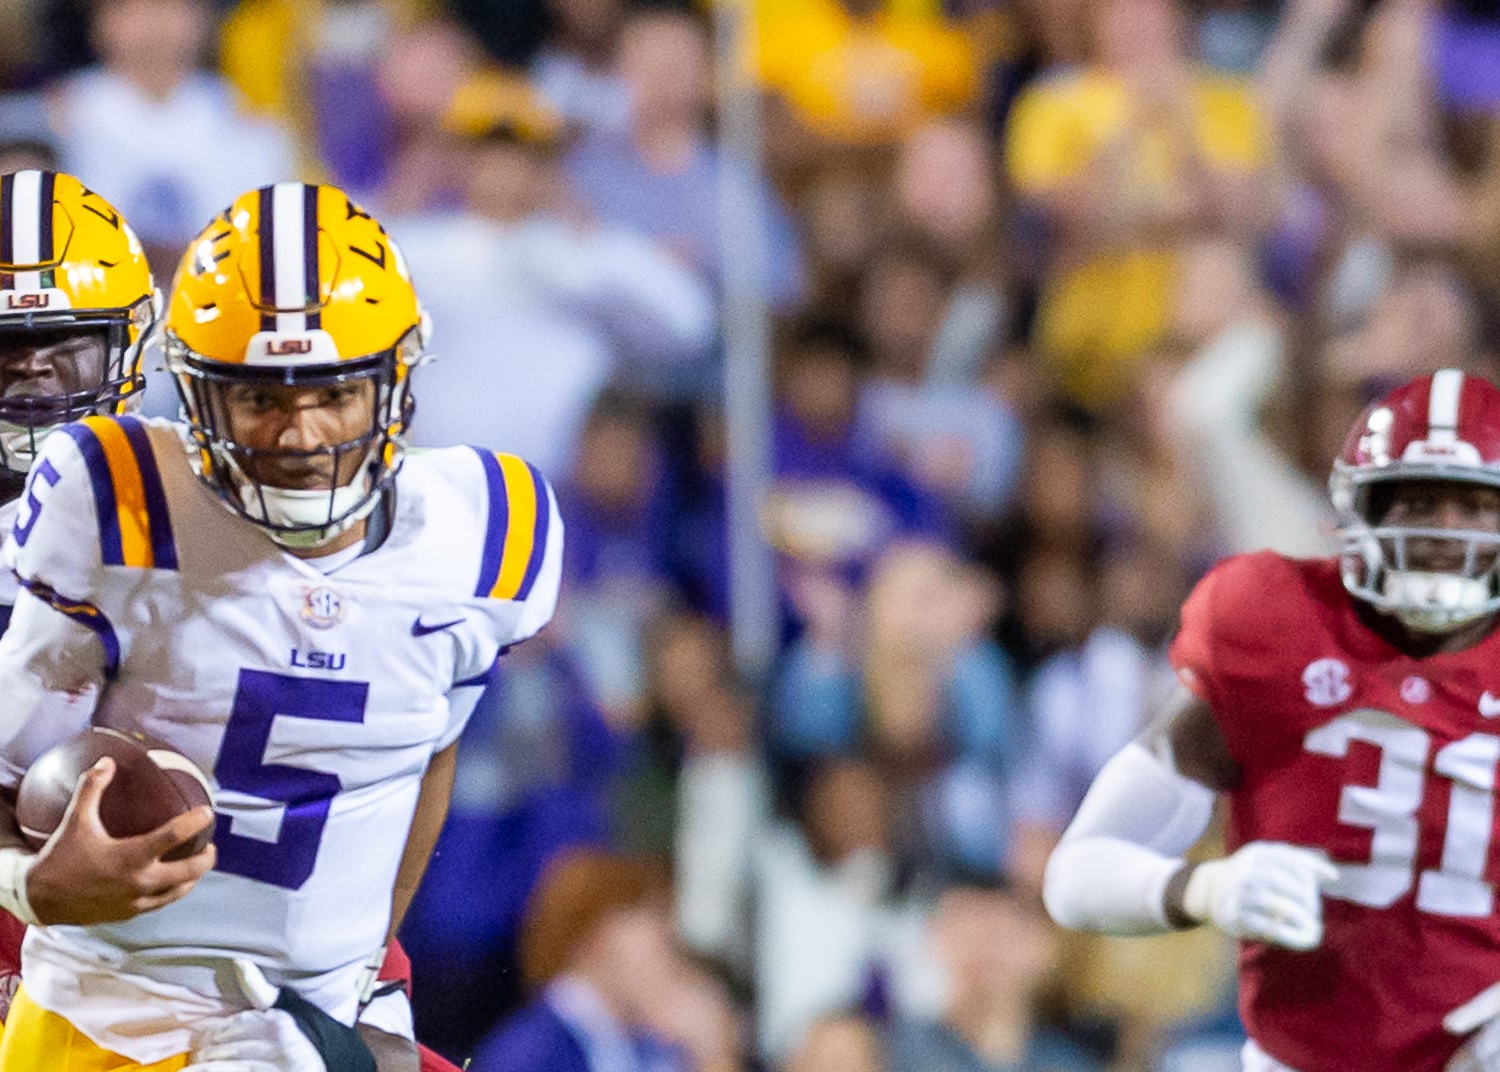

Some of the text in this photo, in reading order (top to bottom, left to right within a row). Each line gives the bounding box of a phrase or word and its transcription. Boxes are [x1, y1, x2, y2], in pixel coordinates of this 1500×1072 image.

[8, 293, 49, 309] LSU
[290, 648, 346, 670] LSU
[213, 667, 370, 891] 5
[1303, 707, 1500, 918] 31
